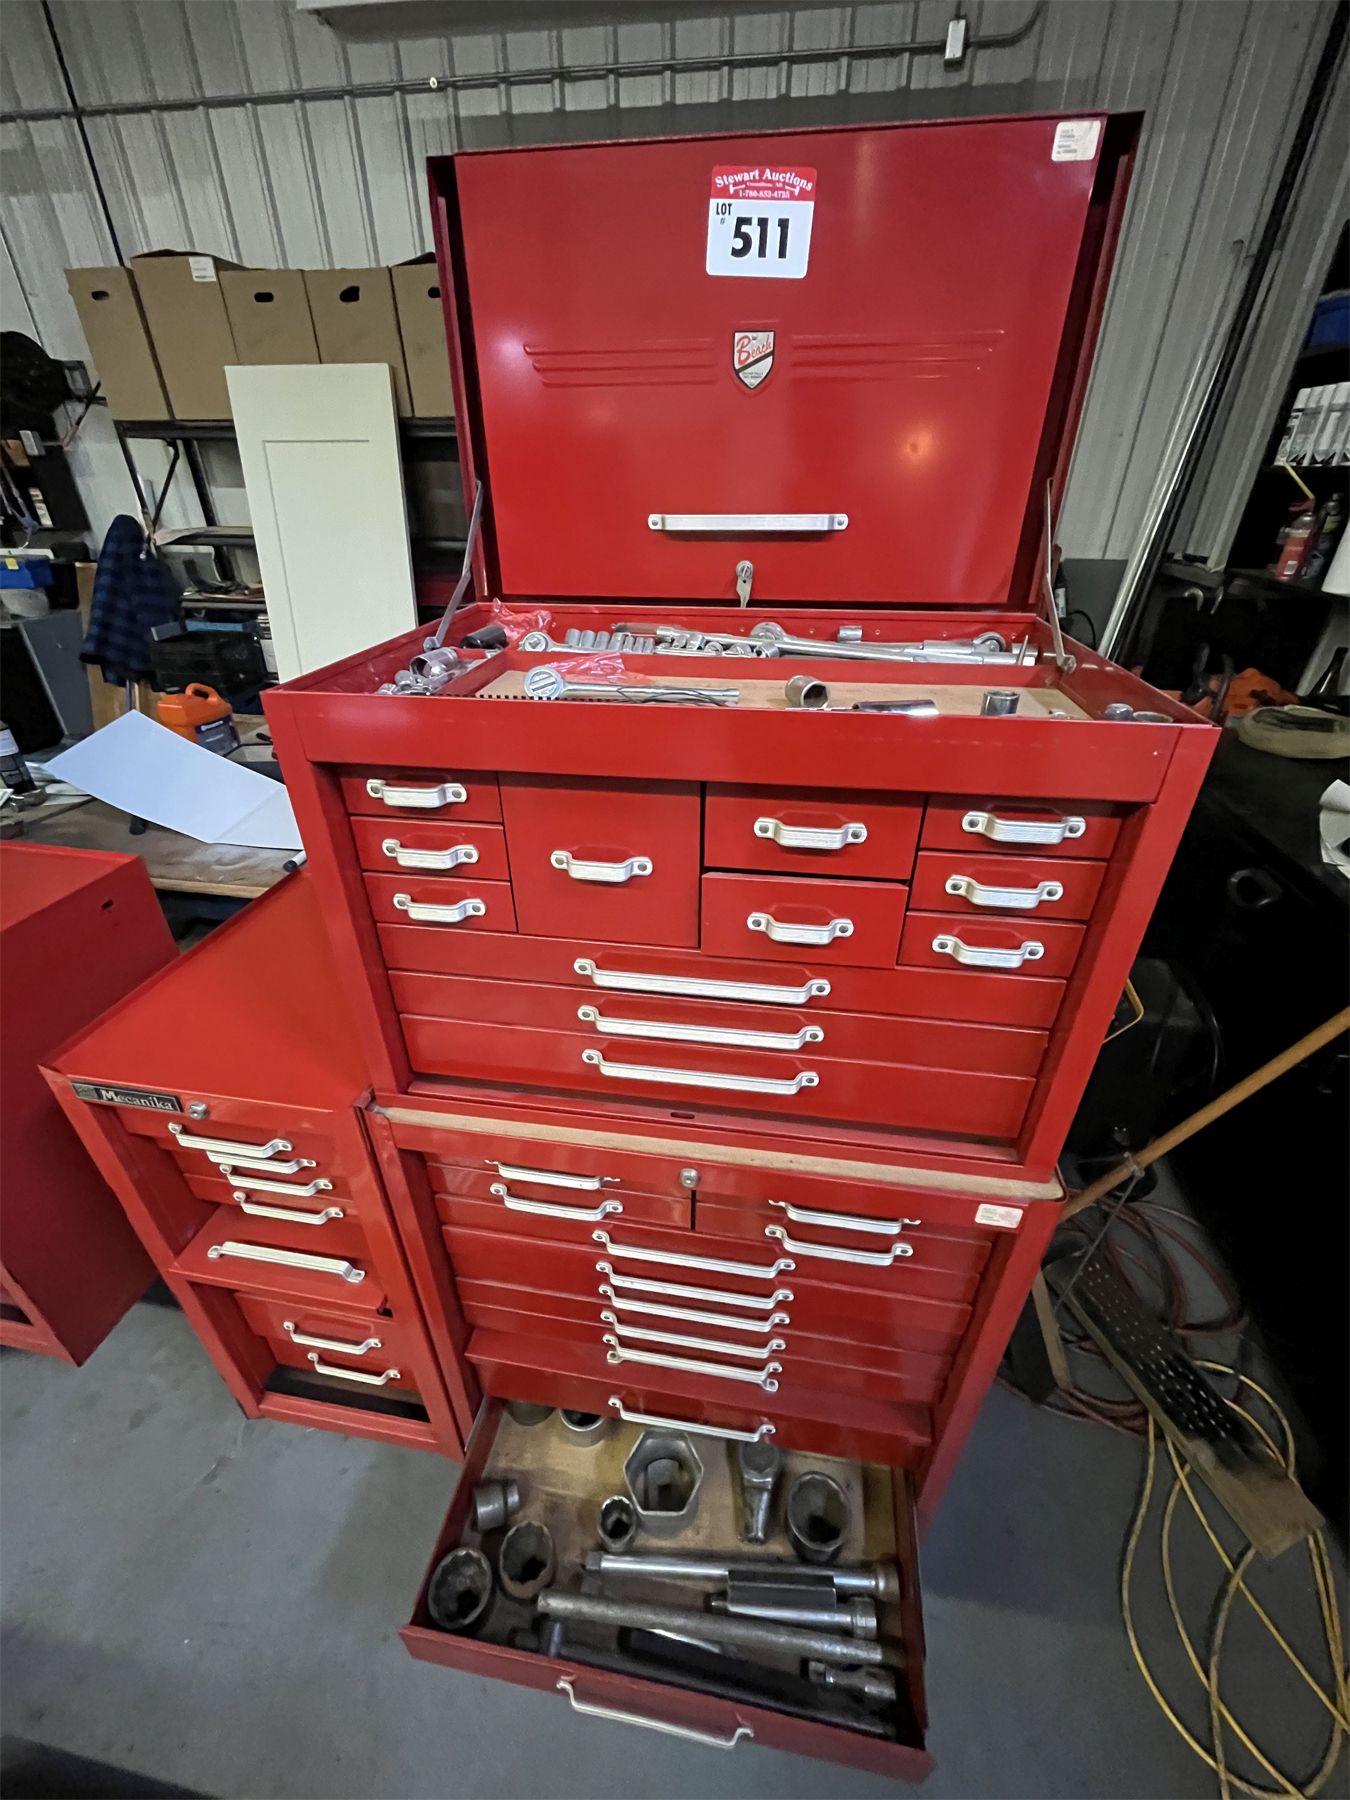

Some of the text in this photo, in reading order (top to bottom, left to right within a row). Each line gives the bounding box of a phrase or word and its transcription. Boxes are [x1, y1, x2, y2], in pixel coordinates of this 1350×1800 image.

[715, 168, 813, 191] Stewart Auctions
[716, 202, 732, 216] LOT
[731, 216, 790, 259] 511
[736, 334, 772, 366] Beach
[101, 1089, 174, 1110] Mecanika
